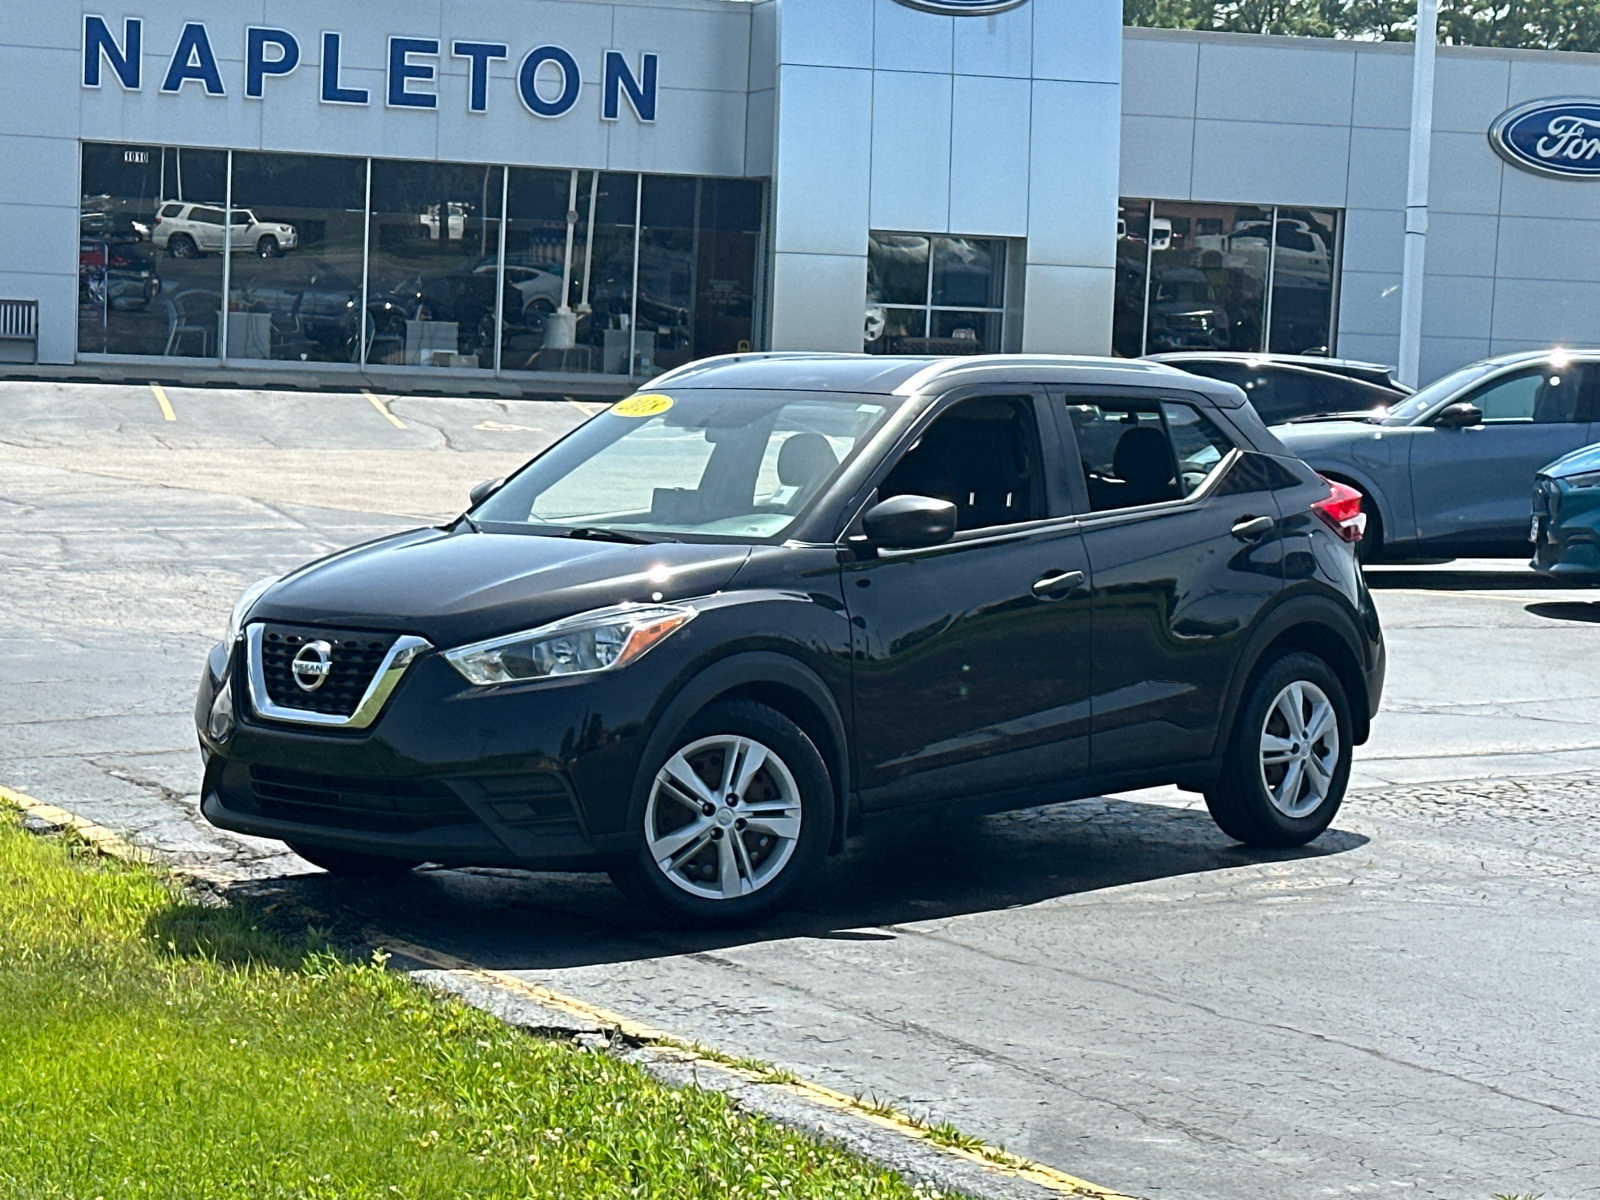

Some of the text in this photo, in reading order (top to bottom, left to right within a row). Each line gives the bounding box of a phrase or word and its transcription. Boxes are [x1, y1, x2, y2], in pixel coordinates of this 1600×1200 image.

[82, 14, 659, 123] NAPLETON
[1536, 115, 1600, 160] For
[124, 151, 149, 163] 1010
[294, 662, 323, 674] NISSAN
